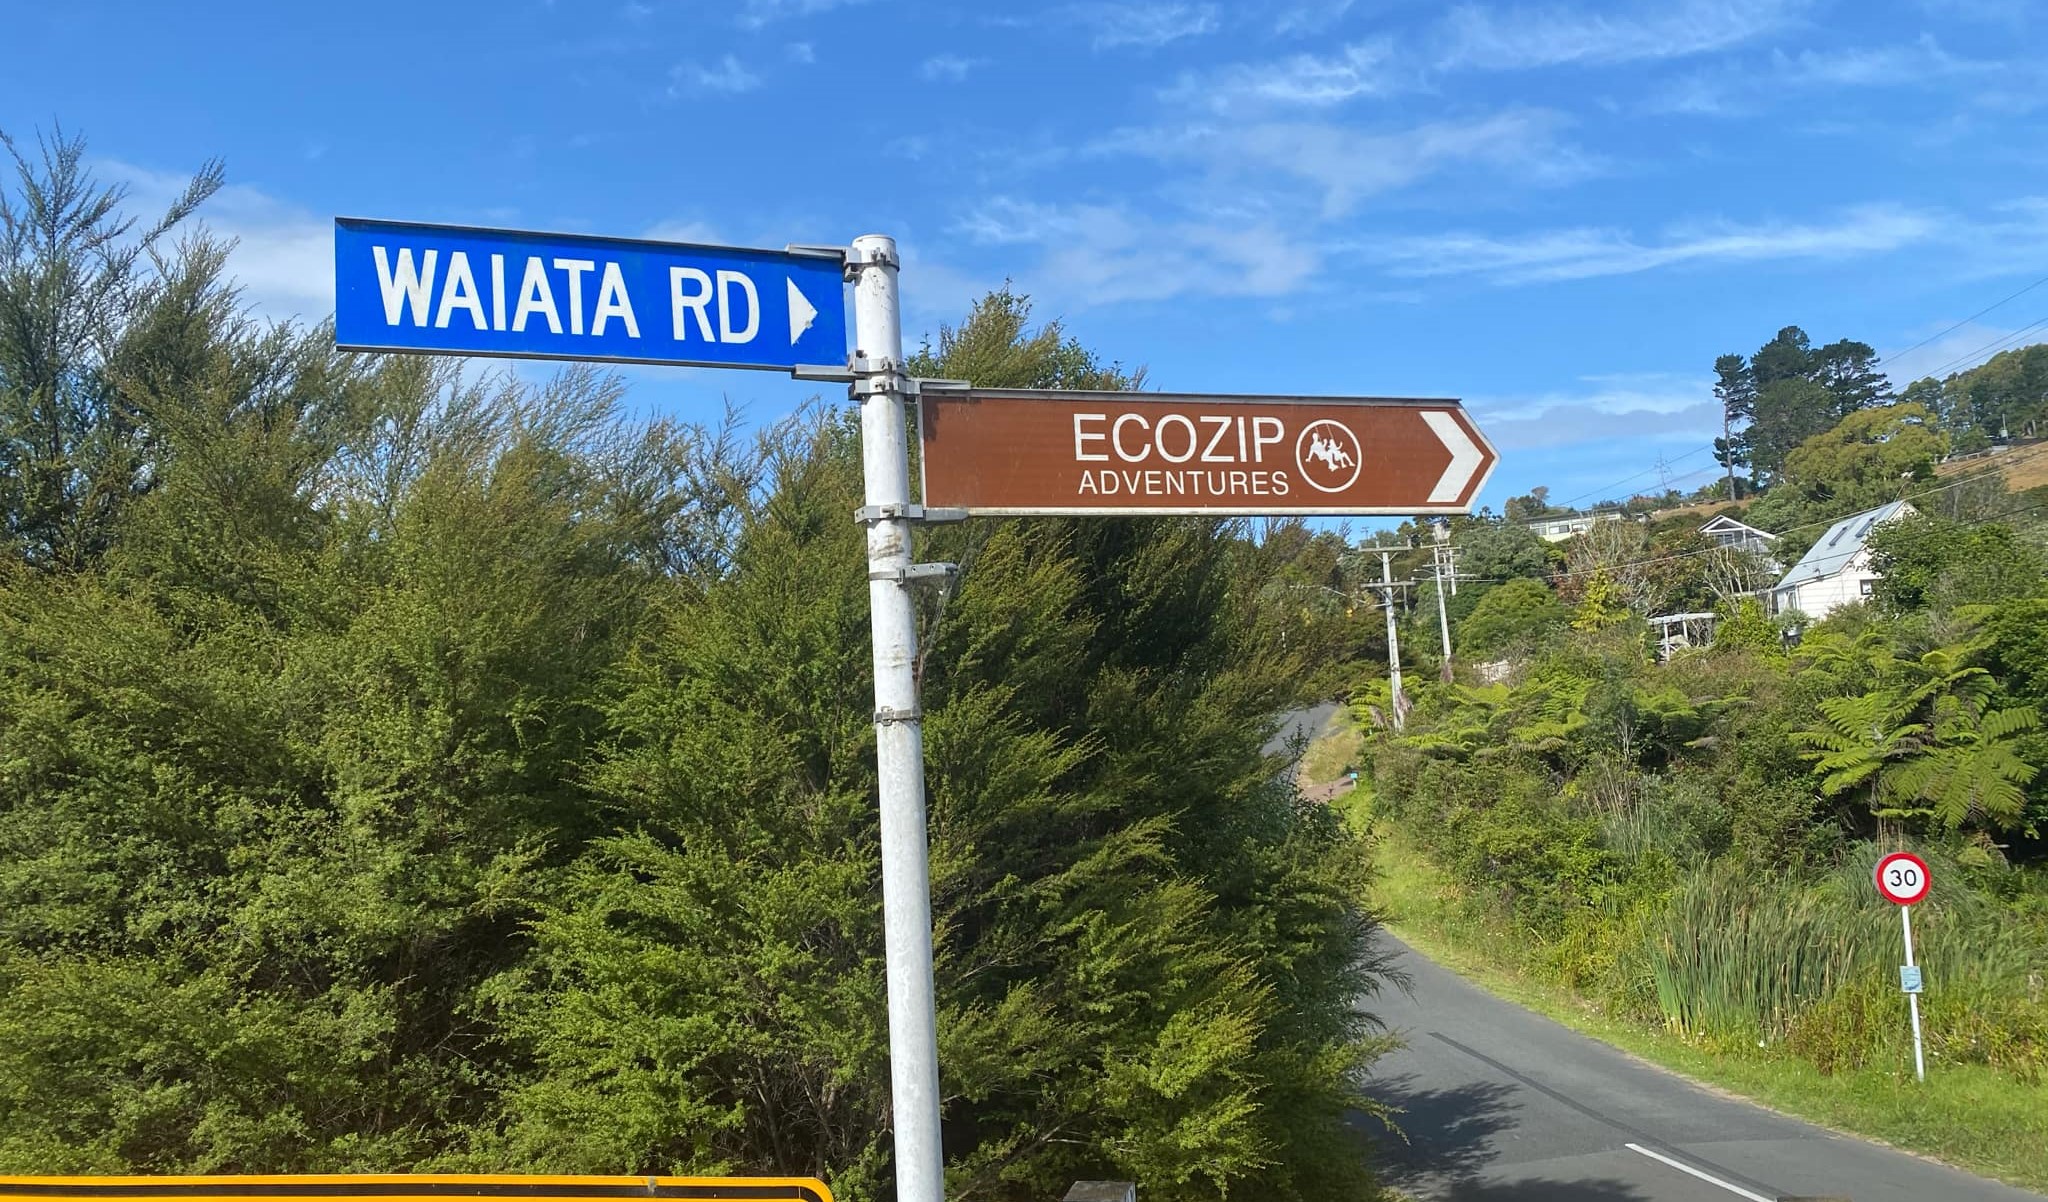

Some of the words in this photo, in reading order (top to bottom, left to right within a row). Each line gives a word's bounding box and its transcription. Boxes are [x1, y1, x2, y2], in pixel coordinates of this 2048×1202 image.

[372, 246, 640, 338] WAIATA
[669, 266, 760, 344] RD
[1073, 413, 1286, 463] ECOZIP
[1078, 469, 1289, 495] ADVENTURES
[1890, 869, 1917, 887] 30
